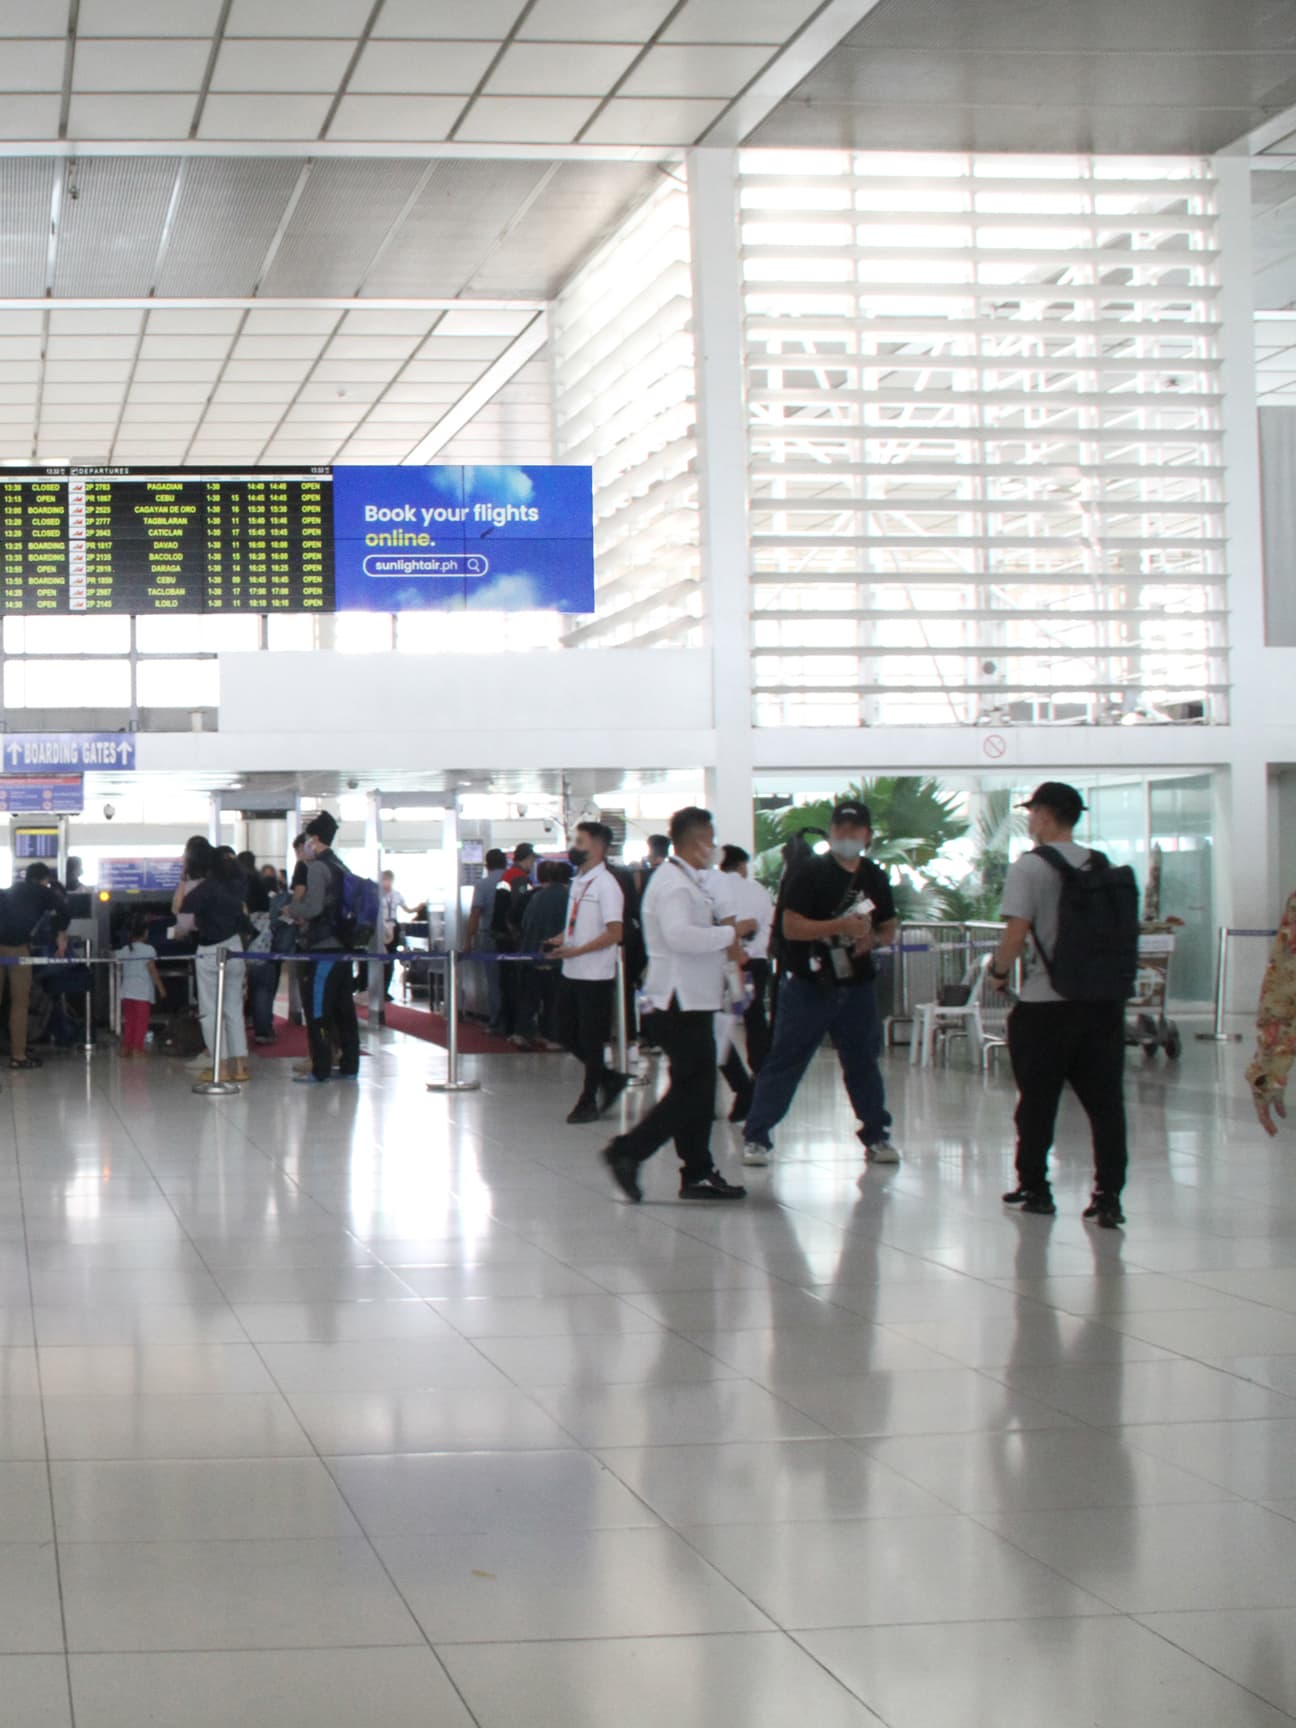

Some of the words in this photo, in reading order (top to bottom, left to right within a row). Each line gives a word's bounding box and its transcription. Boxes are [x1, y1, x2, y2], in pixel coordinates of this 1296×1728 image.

[79, 467, 129, 475] DEPARTURES
[32, 483, 61, 492] CLOSED
[300, 482, 321, 491] OPEN
[36, 494, 57, 503] OPEN
[155, 494, 176, 503] CEBU
[301, 493, 321, 502] OPEN
[28, 506, 64, 514] BOARDING
[301, 504, 321, 513] OPEN
[365, 506, 416, 522] Book
[421, 508, 469, 526] your
[474, 504, 539, 526] flights
[32, 518, 61, 526] CLOSED
[301, 516, 321, 525] OPEN
[32, 529, 61, 538] CLOSED
[148, 528, 183, 537] CATICLAN
[302, 527, 322, 536] OPEN
[365, 529, 436, 547] online.
[28, 542, 65, 550] BOARDING
[153, 541, 179, 550] DAVAO
[302, 540, 322, 549] OPEN
[28, 553, 65, 562] BOARDING
[302, 552, 322, 560] OPEN
[37, 565, 57, 573] OPEN
[303, 564, 322, 572] OPEN
[375, 559, 458, 575] sunlightair.ph
[29, 577, 65, 585] BOARDING
[157, 576, 176, 584] CEBU
[303, 575, 323, 584] OPEN
[38, 588, 56, 597] OPEN
[303, 586, 323, 595] OPEN
[39, 600, 56, 609] OPEN
[304, 598, 323, 607] OPEN
[24, 741, 78, 764] BOARDING
[83, 741, 117, 764] GATES
